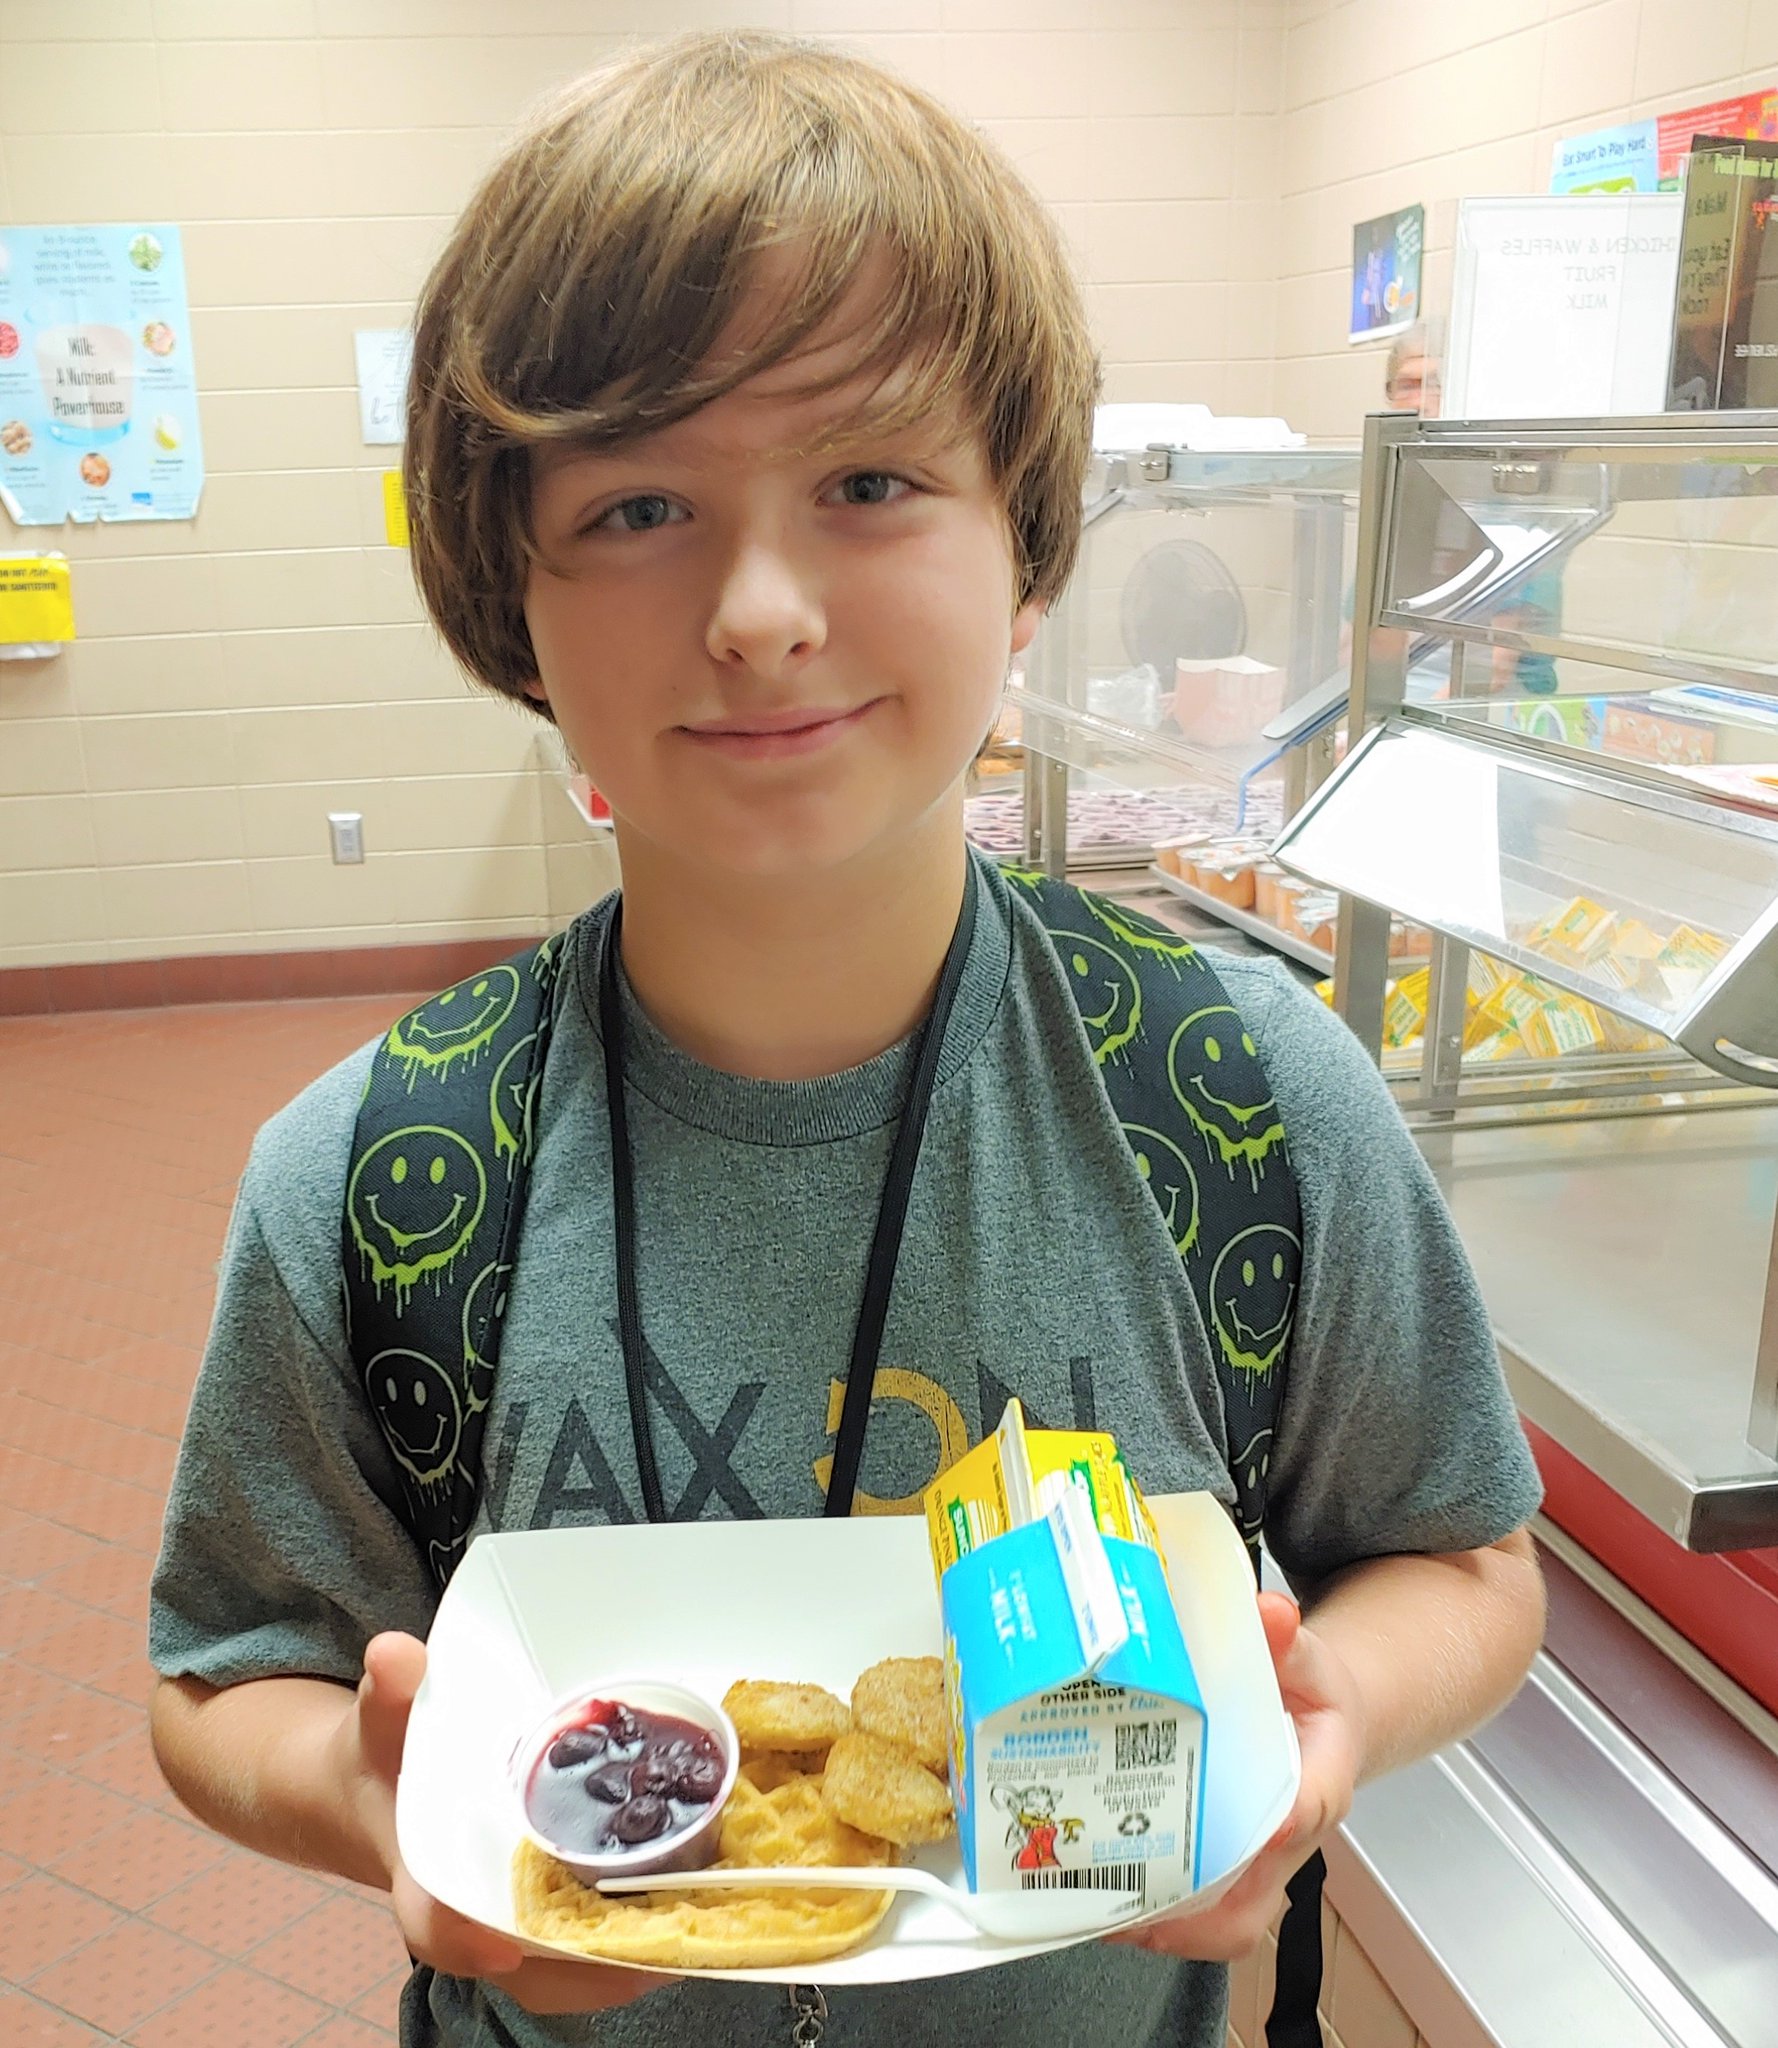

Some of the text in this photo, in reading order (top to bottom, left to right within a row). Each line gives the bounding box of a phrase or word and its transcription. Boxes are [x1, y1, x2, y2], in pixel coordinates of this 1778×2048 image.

[66, 367, 117, 386] Nutrient
[52, 397, 126, 417] Powerhouse
[1040, 1687, 1127, 1707] OTHER SIDE
[1020, 1706, 1100, 1723] APPROVED
[1107, 1702, 1124, 1714] BY
[1004, 1726, 1088, 1746] BORDEN
[991, 1741, 1101, 1760] SUSTAINABILITY
